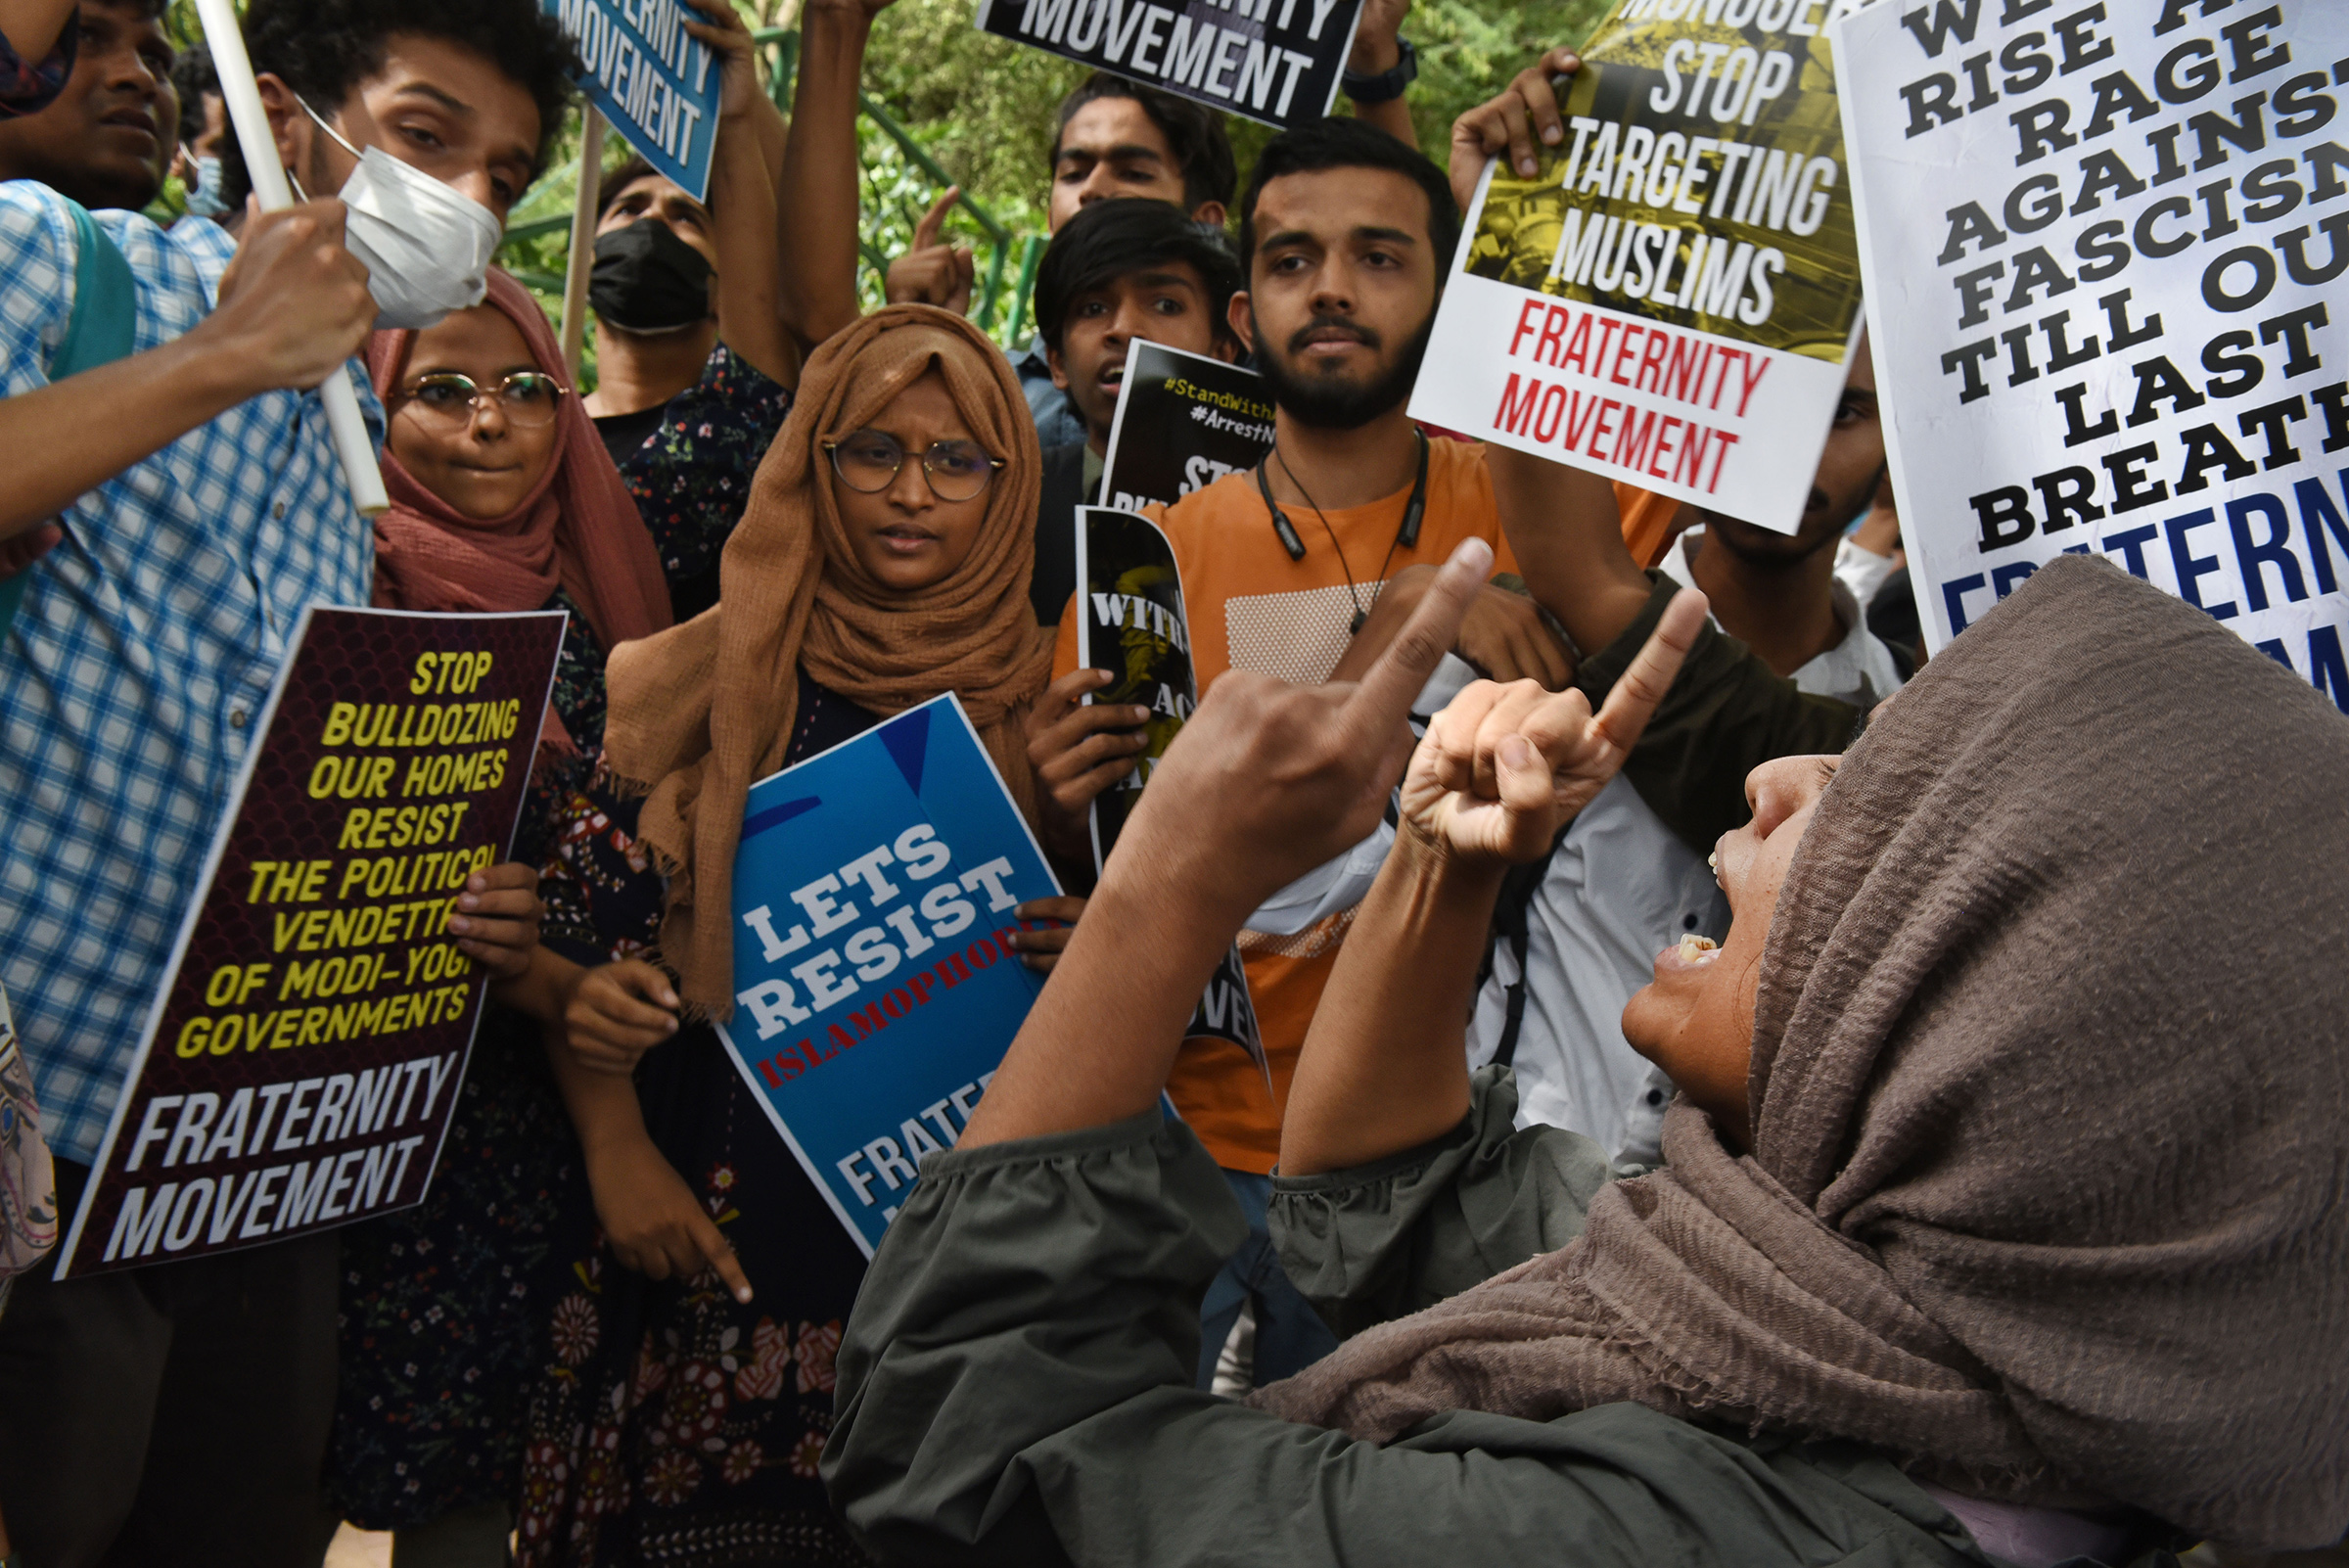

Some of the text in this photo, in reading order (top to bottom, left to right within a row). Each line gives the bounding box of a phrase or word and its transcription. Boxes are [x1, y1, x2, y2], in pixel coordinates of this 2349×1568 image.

[1019, 0, 1313, 118] MOVEMENT
[1649, 39, 1793, 125] STOP
[1900, 1, 2115, 139] RISE
[2009, 4, 2291, 167] RAGE
[1562, 115, 1838, 236] TARGETING
[1937, 57, 2349, 266] AGAINS
[1548, 208, 1785, 326] MUSLIMS
[1509, 299, 1773, 417] FRATERNITY
[1941, 288, 2164, 404] TILL
[2055, 301, 2329, 448] LAST
[1178, 455, 1248, 497] ST
[1494, 373, 1739, 493] MOVEMENT
[321, 698, 520, 747] BULLDOZING
[410, 651, 492, 695] STOP
[307, 749, 508, 799] OUR HOMES
[338, 802, 469, 850] RESIST
[247, 860, 333, 903] THE
[742, 823, 951, 963] LETS
[206, 963, 272, 1007] OF
[736, 855, 1018, 1040] RESIST
[757, 919, 1063, 1090] ISLAMOPHO
[176, 983, 470, 1058] GOVERNMENTS
[124, 1051, 458, 1173] FRATERNITY
[836, 1070, 996, 1207] FRAT
[102, 1134, 425, 1263] MOVEMENT
